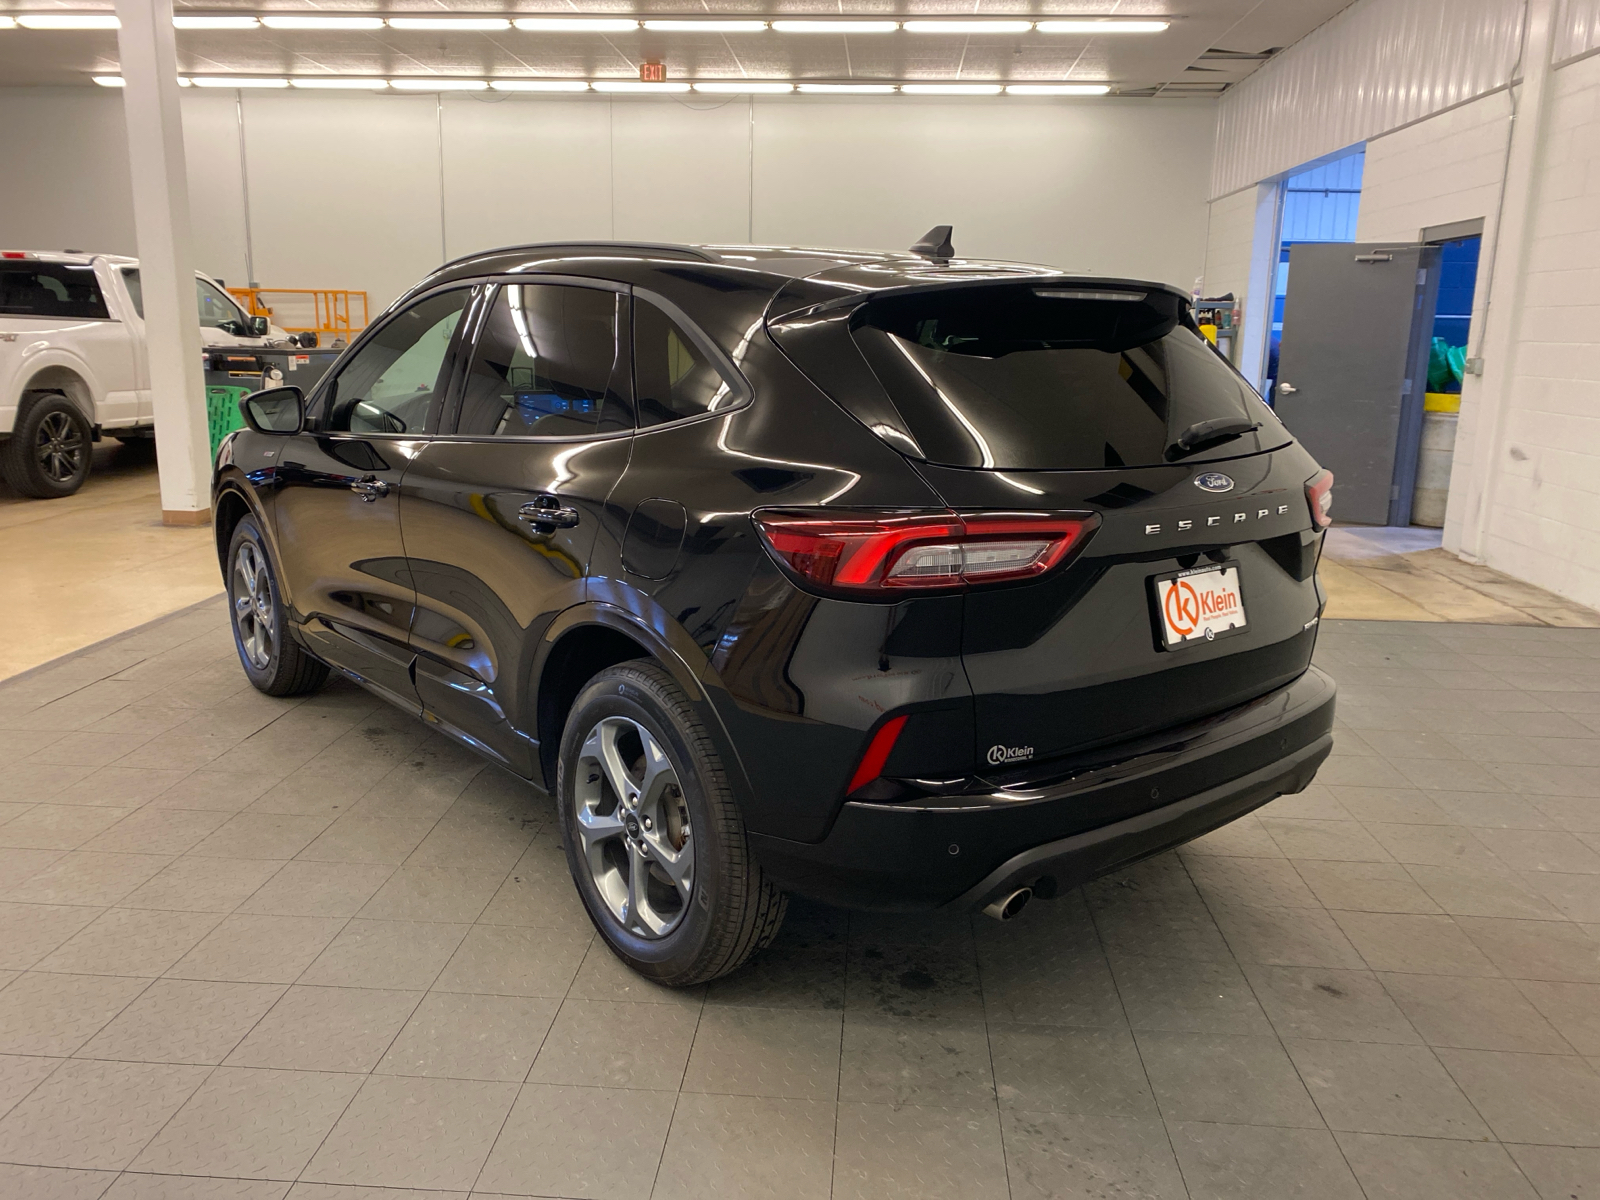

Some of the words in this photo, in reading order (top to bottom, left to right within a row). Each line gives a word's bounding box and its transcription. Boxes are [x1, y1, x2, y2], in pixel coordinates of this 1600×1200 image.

[643, 64, 663, 81] EXIT
[1205, 475, 1228, 488] Ford
[1145, 505, 1288, 535] ESCAPE
[1200, 587, 1237, 615] Klein
[1007, 746, 1034, 757] Klein
